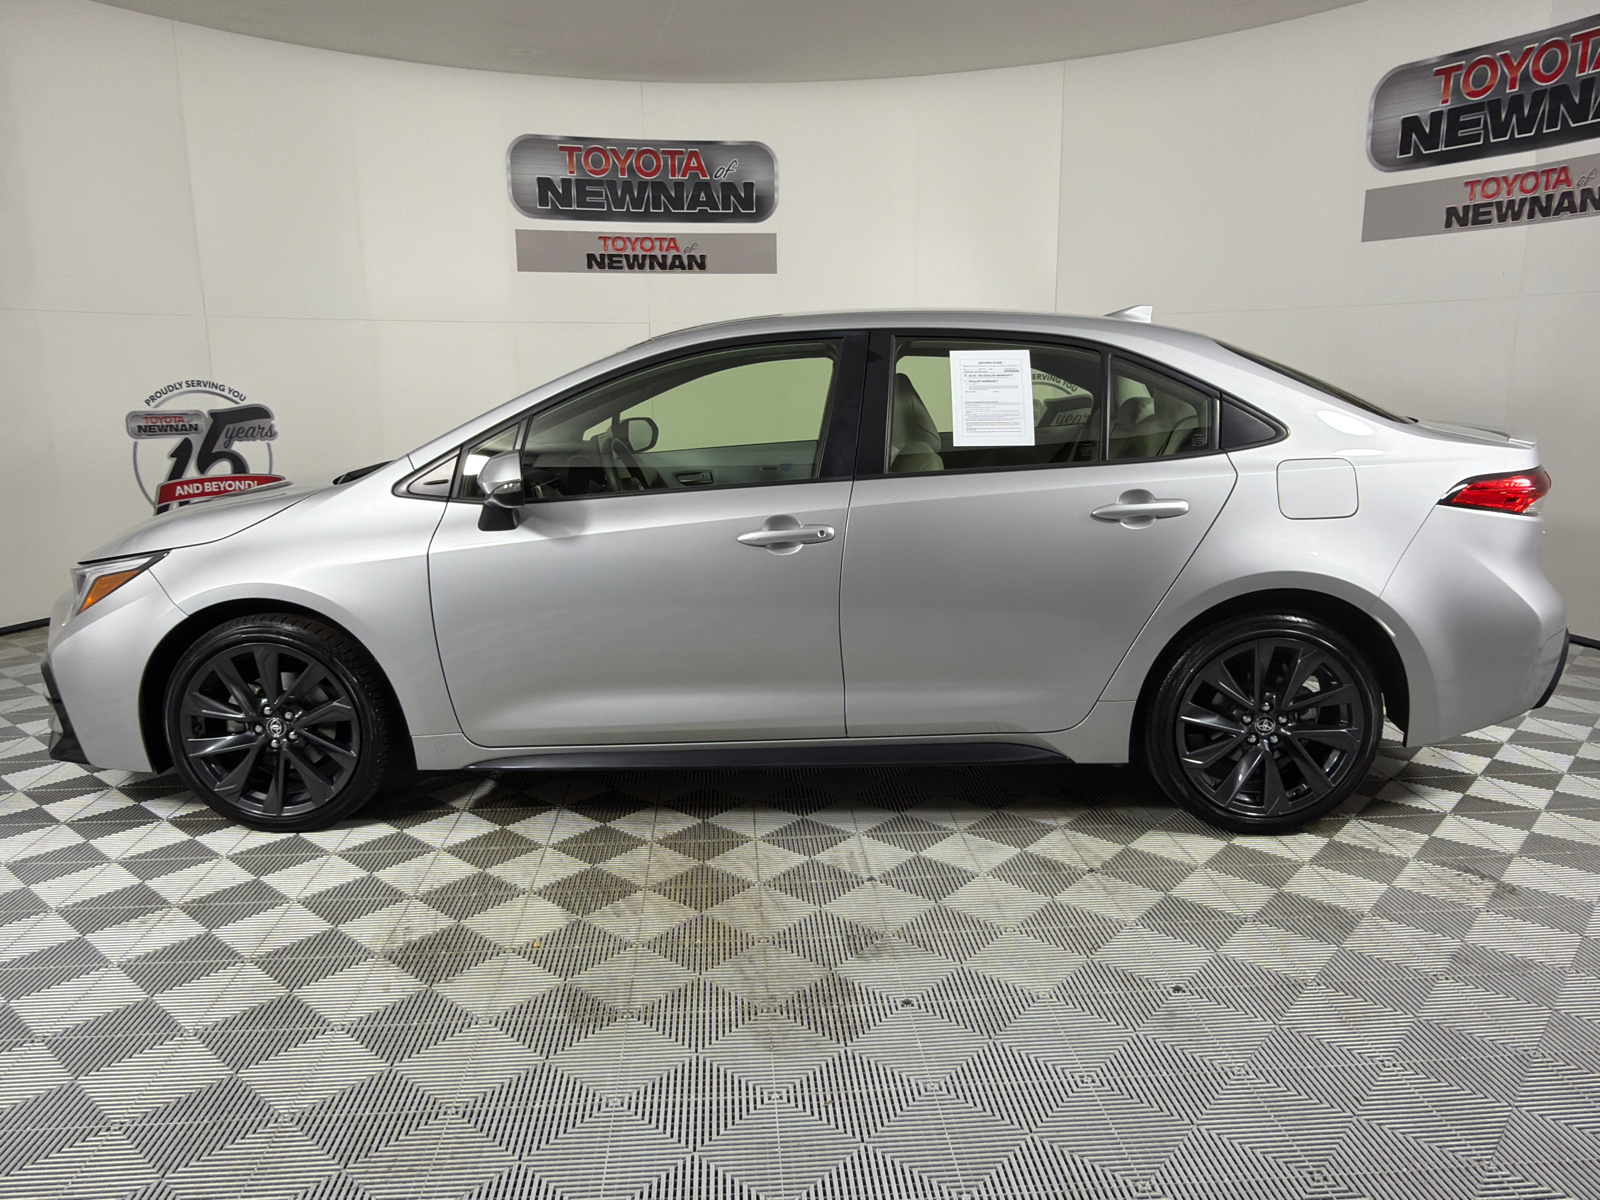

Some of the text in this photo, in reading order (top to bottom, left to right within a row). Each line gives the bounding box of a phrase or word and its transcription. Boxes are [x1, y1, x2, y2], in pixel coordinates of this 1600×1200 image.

[1397, 77, 1600, 158] NEWN
[558, 145, 738, 180] TOYOTA of
[536, 177, 756, 212] NEWNAN
[1464, 166, 1597, 201] TOYOTA of
[1444, 187, 1600, 229] NEWNAN
[597, 235, 697, 253] TOYOTA of
[586, 253, 706, 270] NEWNAN
[144, 379, 247, 407] PROUDLY SERVING YOU
[1032, 373, 1078, 392] ERVING YOU
[137, 423, 199, 434] NEWNAN
[143, 415, 185, 424] TOYOTA
[1055, 413, 1091, 425] year
[224, 423, 276, 449] years
[175, 483, 203, 496] AND
